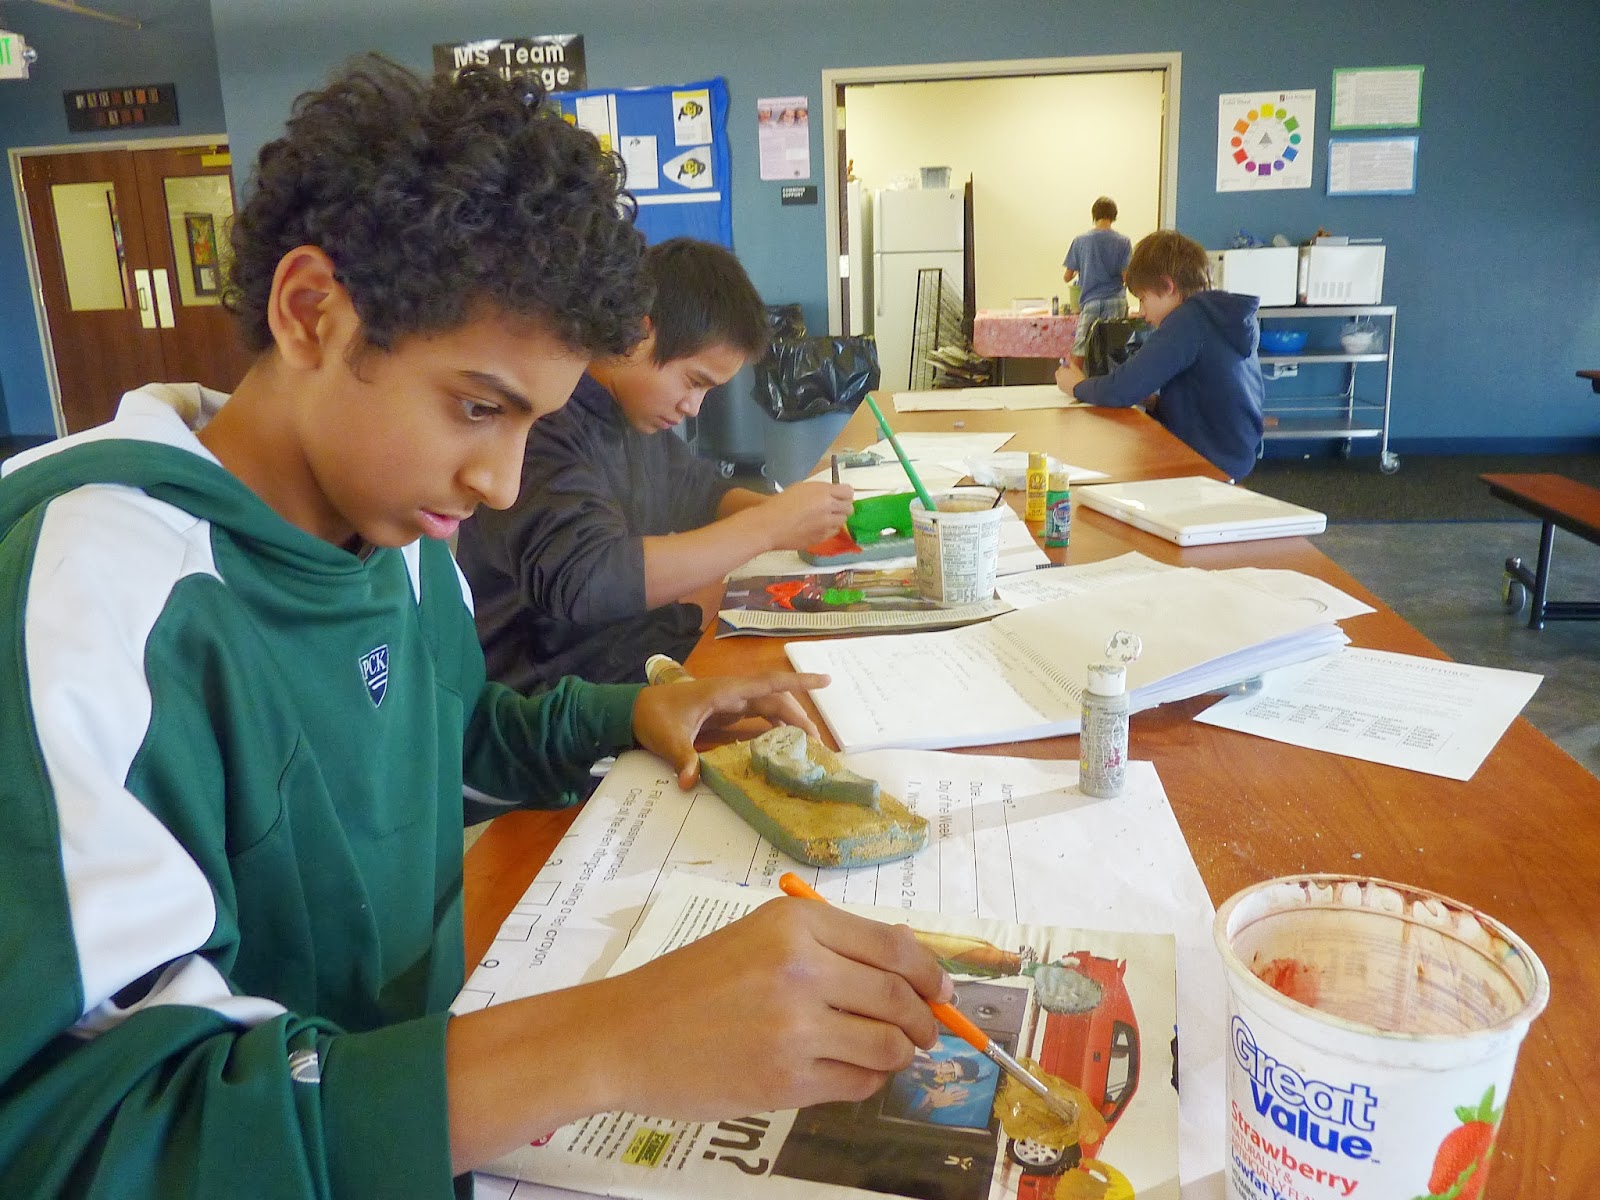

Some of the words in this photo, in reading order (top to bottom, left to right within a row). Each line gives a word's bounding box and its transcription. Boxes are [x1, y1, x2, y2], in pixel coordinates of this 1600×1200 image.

[453, 46, 490, 68] MS
[500, 42, 564, 65] Team
[362, 650, 386, 680] PCK
[936, 780, 951, 793] Day
[599, 828, 617, 847] even
[619, 820, 645, 847] missing
[939, 815, 952, 839] Week
[562, 882, 586, 906] using
[528, 929, 557, 968] crayon.
[1231, 1015, 1378, 1131] Great
[1250, 1078, 1373, 1160] Value
[1232, 1100, 1358, 1196] Strawberry
[1232, 1121, 1281, 1176] NATURALLY
[1283, 1171, 1293, 1185] &
[1231, 1144, 1268, 1196] Lowfat
